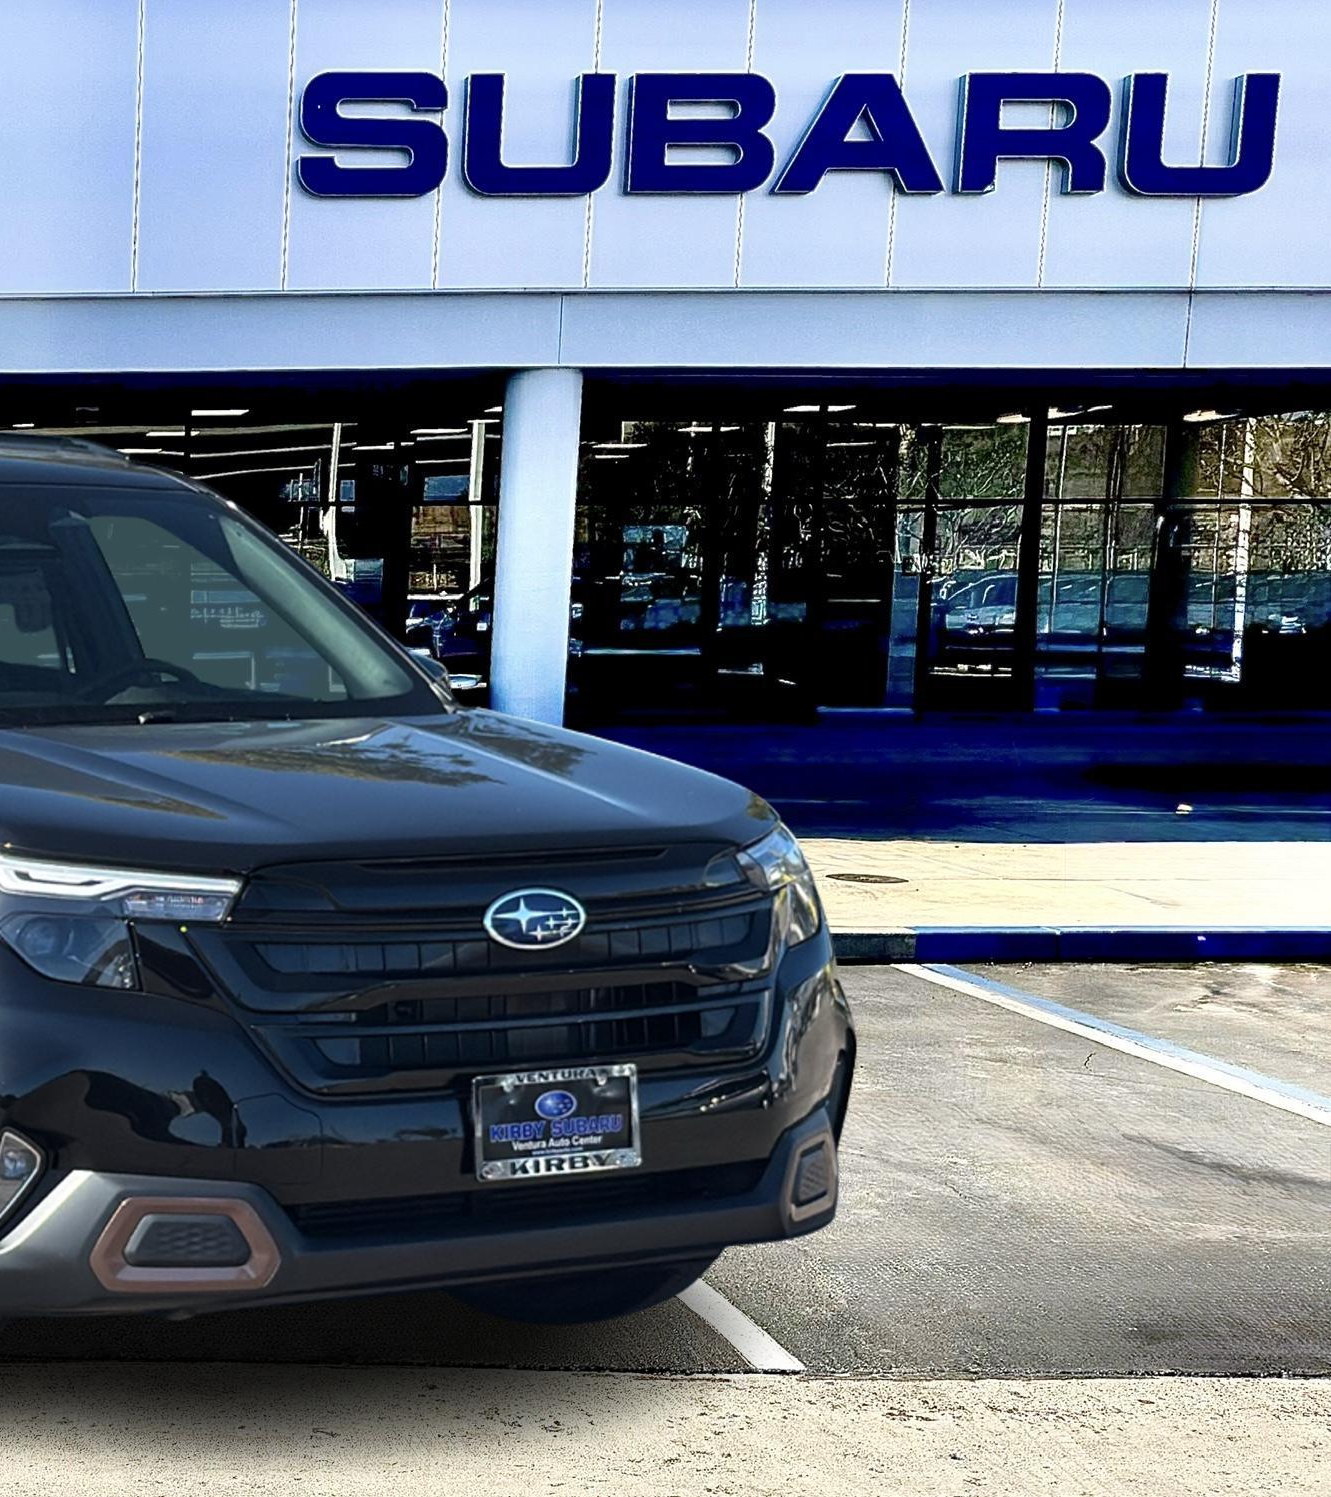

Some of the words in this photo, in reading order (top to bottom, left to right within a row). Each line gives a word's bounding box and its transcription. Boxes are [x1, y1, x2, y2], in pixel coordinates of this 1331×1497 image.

[297, 71, 1280, 197] SUBARU
[516, 1068, 597, 1083] VENTURA
[489, 1120, 546, 1142] KIRBY
[550, 1114, 623, 1137] SUBARU
[511, 1140, 547, 1151] Ventura
[548, 1137, 571, 1147] Auto
[571, 1135, 603, 1145] Center
[509, 1153, 611, 1176] KIRBY
